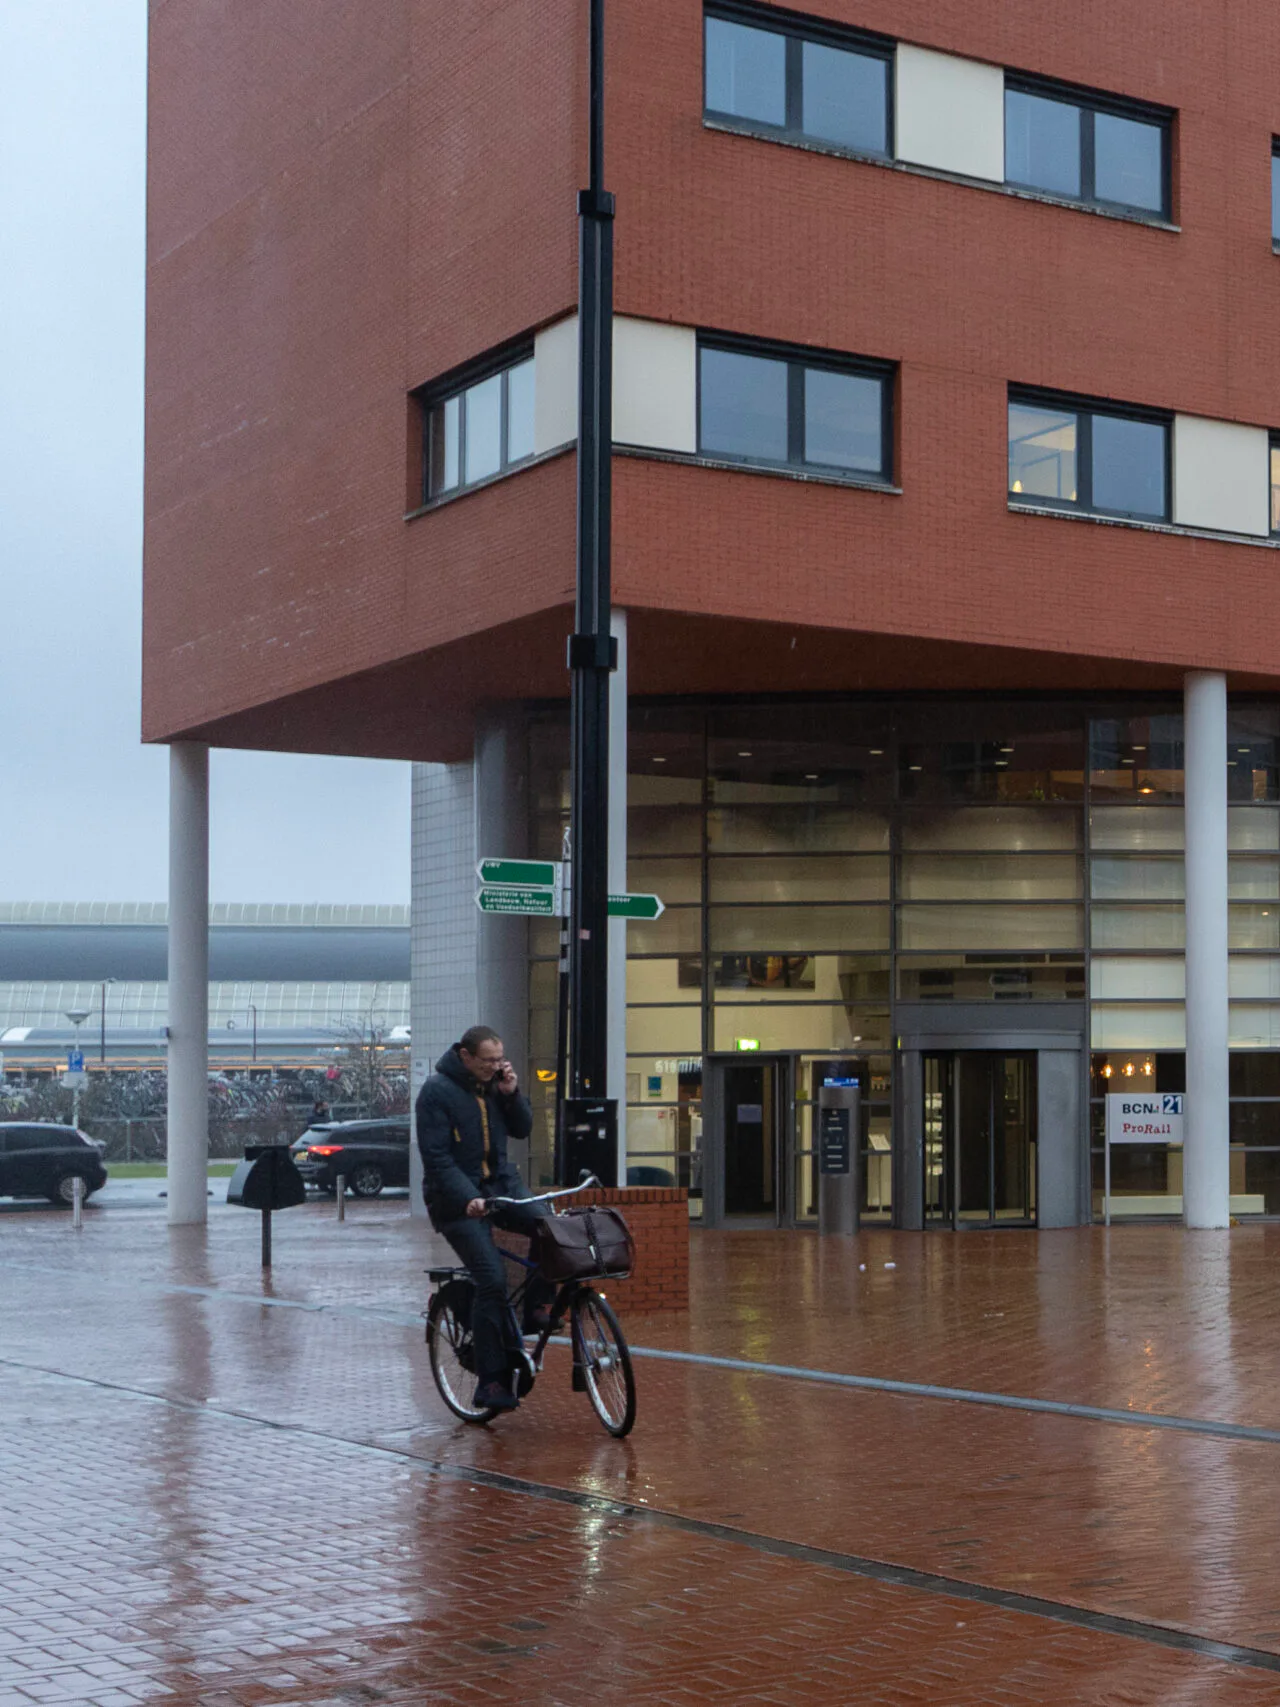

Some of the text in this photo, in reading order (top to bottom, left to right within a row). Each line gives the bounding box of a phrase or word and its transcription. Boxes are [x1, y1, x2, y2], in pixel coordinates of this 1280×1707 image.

[484, 890, 518, 898] Ministerie
[523, 898, 548, 906] Natuur
[496, 903, 552, 912] Voedselkwaliteit
[1122, 1103, 1153, 1114] BCN
[1163, 1095, 1184, 1114] 21
[1122, 1122, 1172, 1134] ProRail
